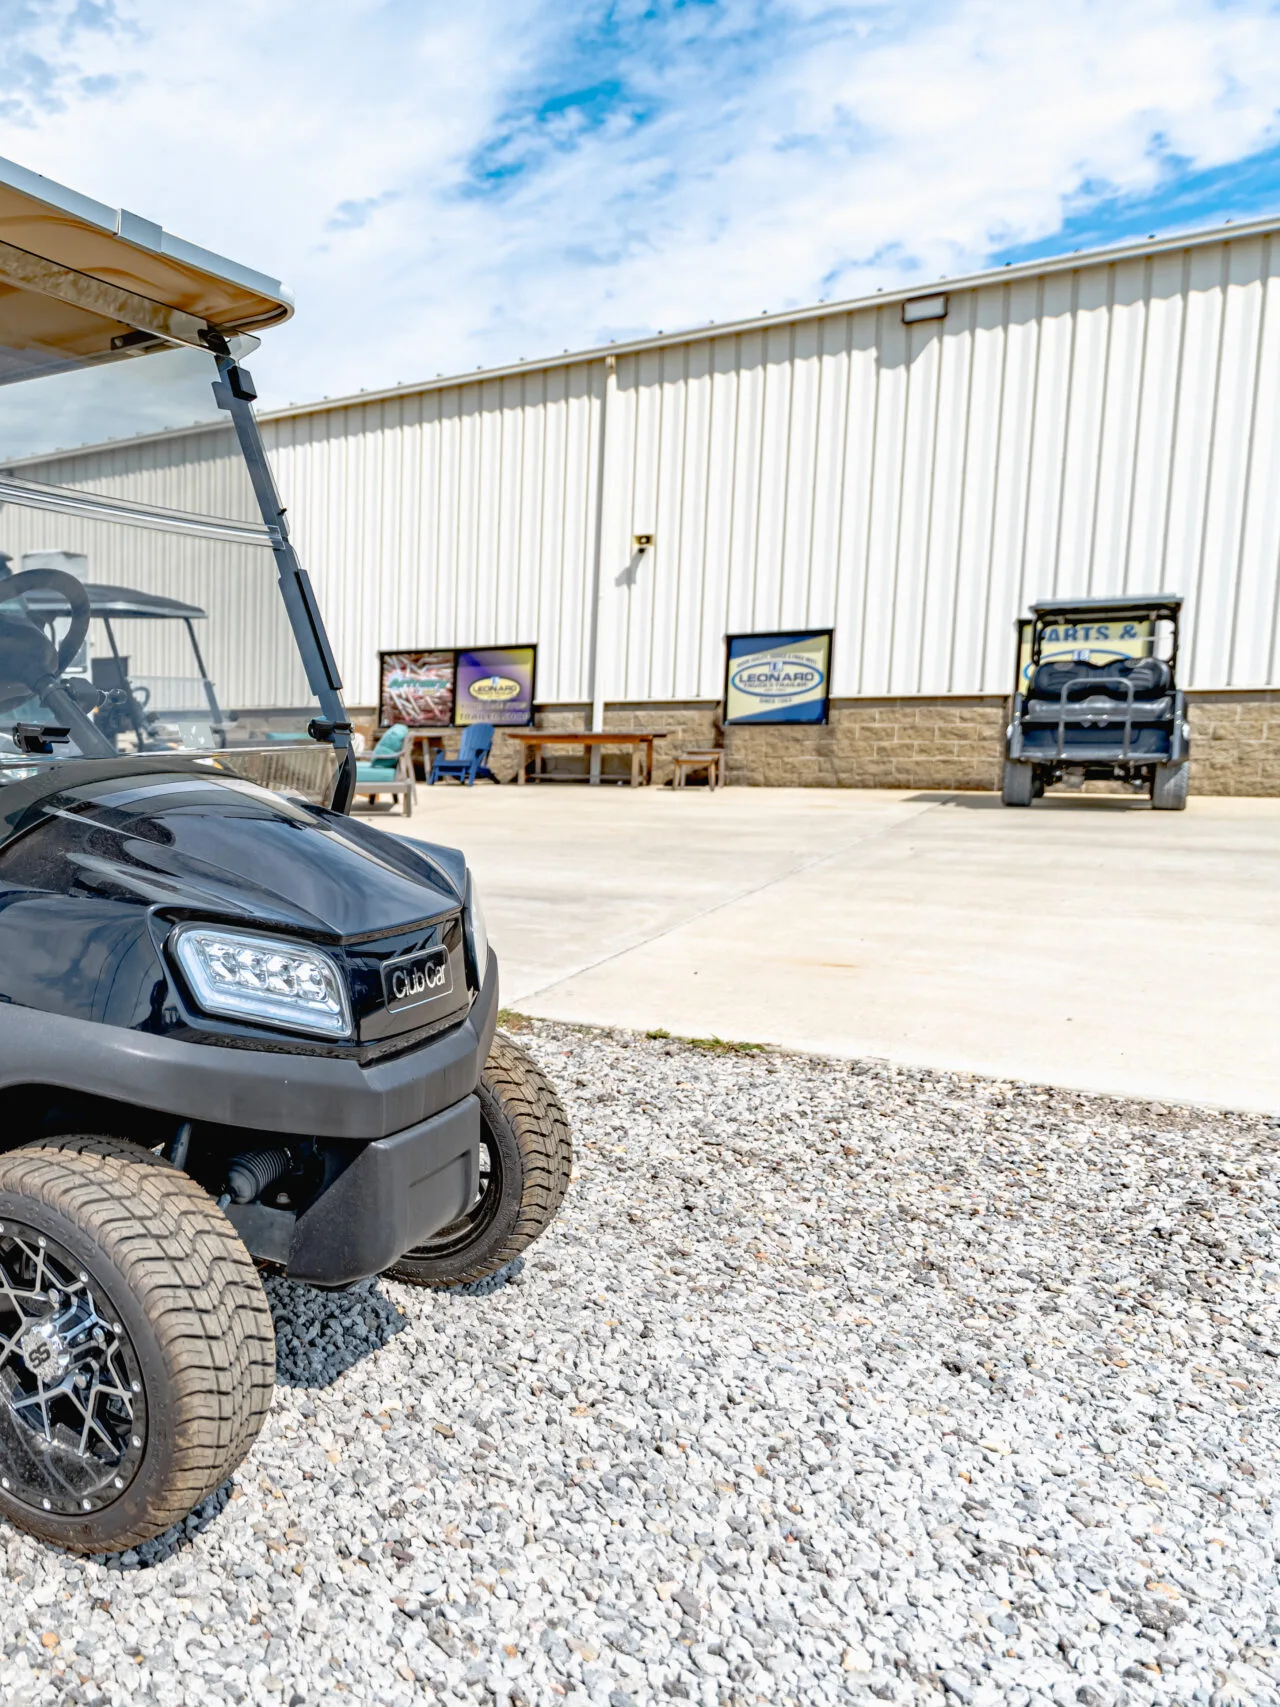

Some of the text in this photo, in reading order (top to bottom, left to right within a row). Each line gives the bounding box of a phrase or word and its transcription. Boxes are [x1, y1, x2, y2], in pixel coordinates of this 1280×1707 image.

[1120, 624, 1137, 639] &
[739, 672, 814, 683] LEONARD
[392, 961, 446, 999] Club Car
